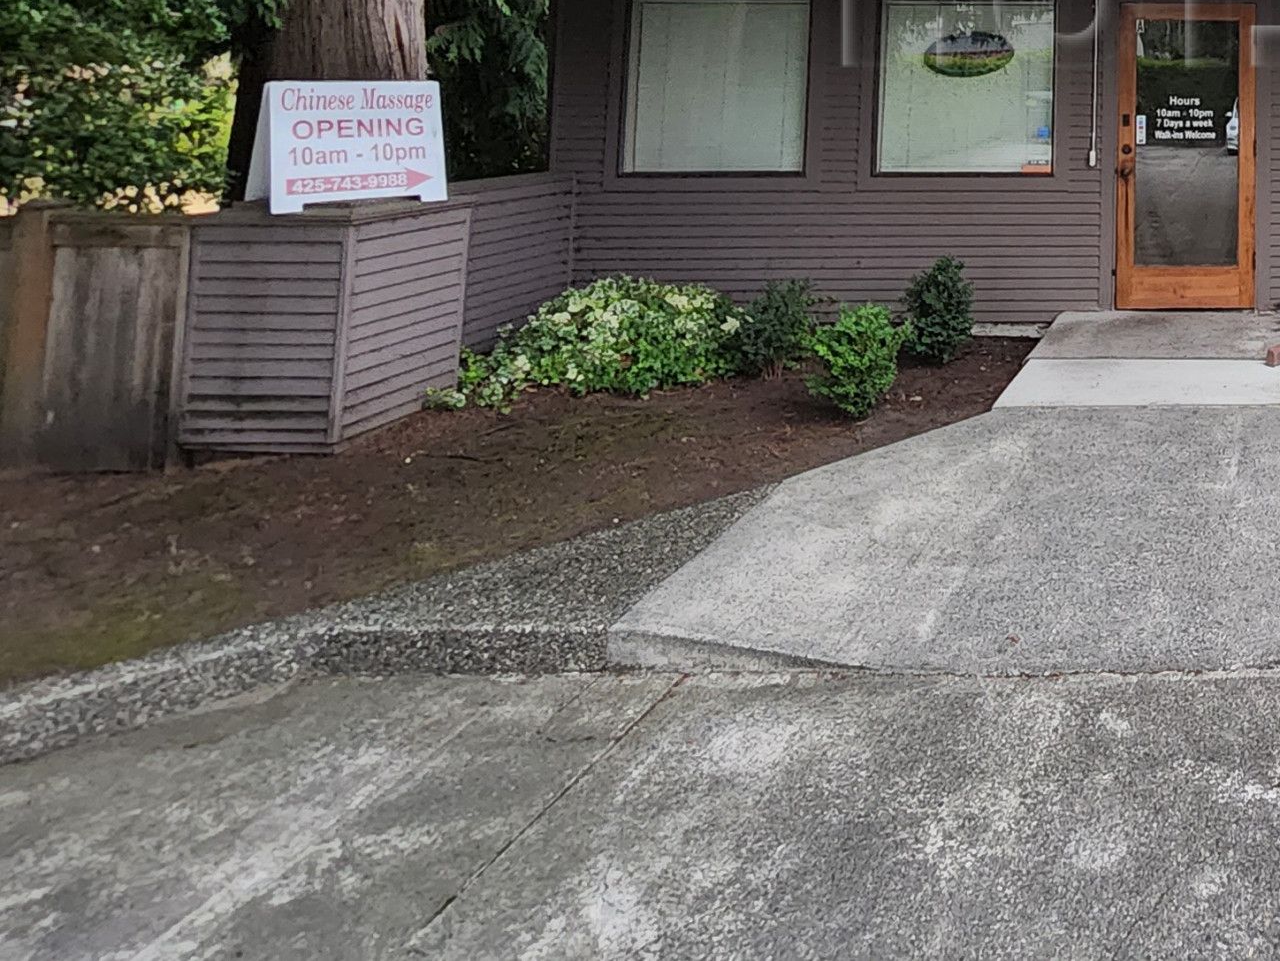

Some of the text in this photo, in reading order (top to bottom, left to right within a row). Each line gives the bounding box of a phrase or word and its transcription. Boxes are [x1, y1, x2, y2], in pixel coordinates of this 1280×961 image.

[281, 88, 433, 113] Chinese Massage
[1169, 96, 1200, 106] Hours
[1156, 108, 1181, 117] 10am
[1188, 108, 1214, 119] 10pm
[1156, 119, 1162, 127] 7
[1163, 119, 1184, 129] Days
[1192, 119, 1213, 128] week
[292, 118, 424, 140] OPENING
[288, 146, 348, 166] 10am
[370, 143, 426, 165] 10pm
[291, 173, 408, 194] 425-743-9988
